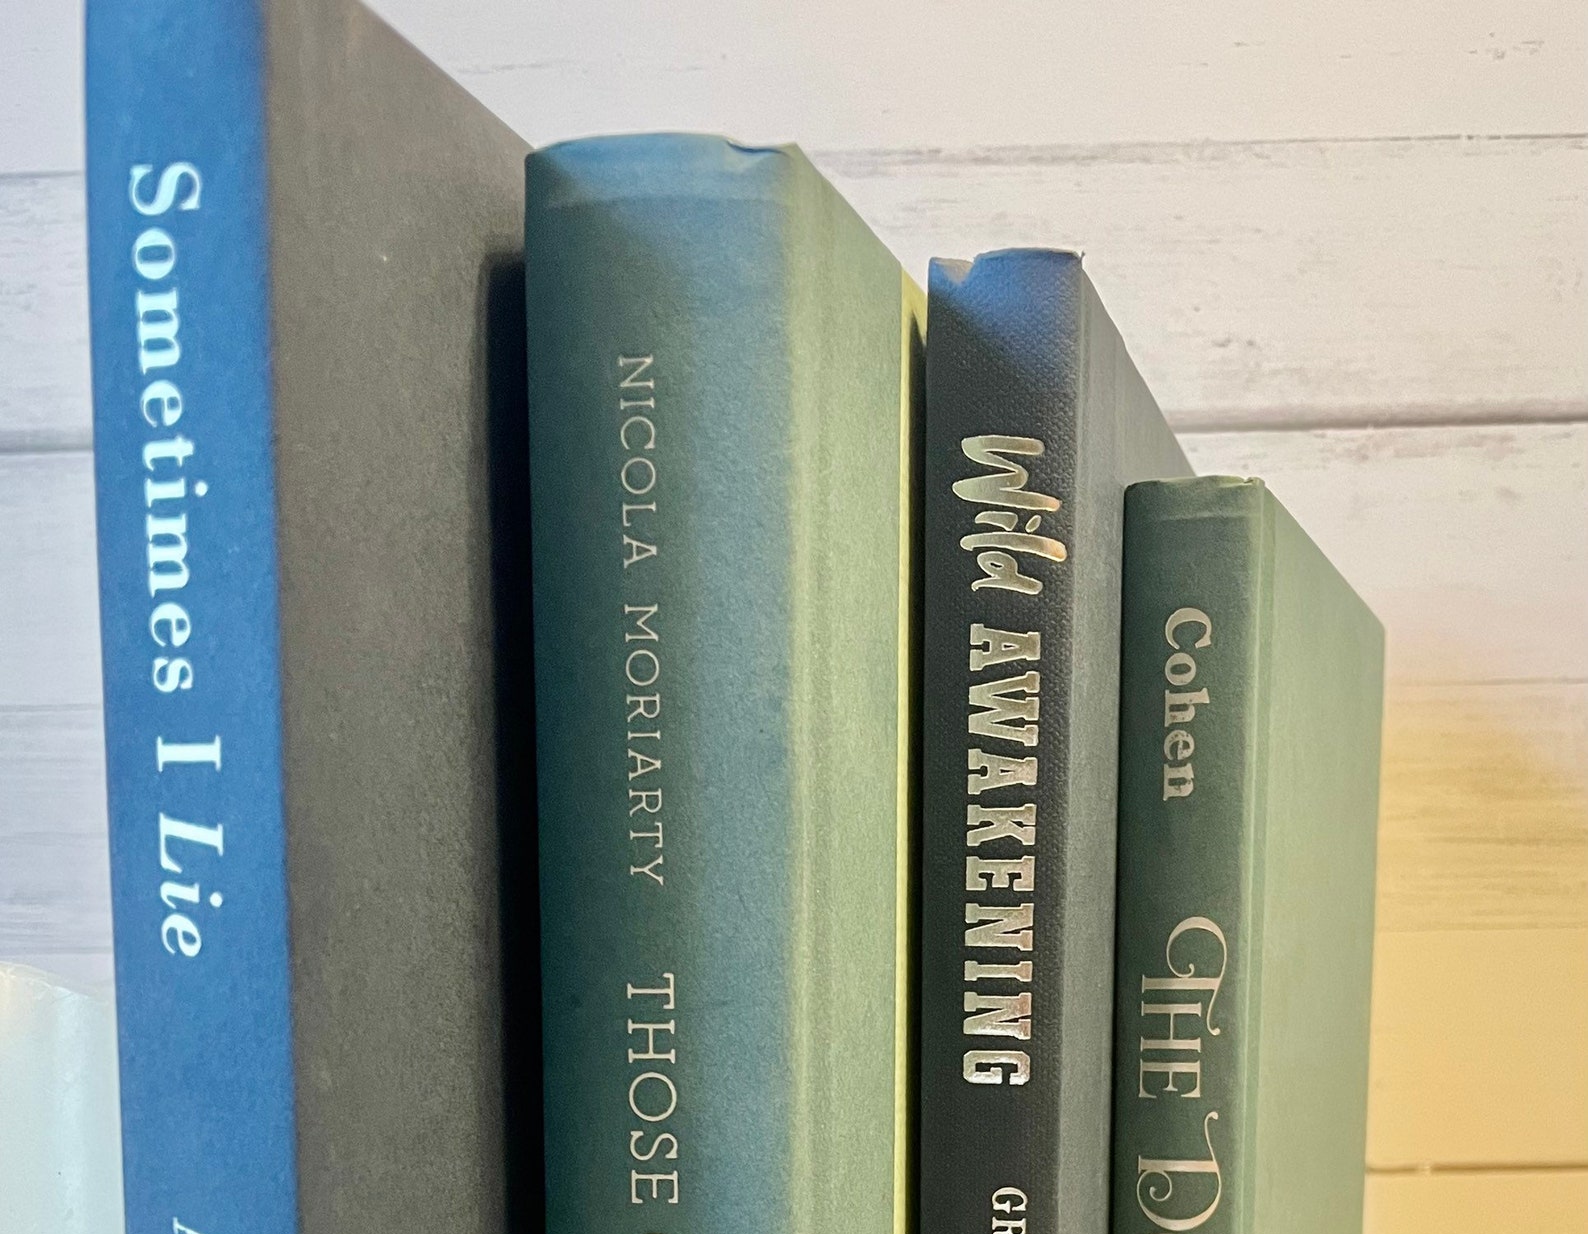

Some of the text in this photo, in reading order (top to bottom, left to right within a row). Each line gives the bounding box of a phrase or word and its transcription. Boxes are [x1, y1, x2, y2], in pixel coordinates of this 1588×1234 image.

[129, 160, 224, 958] Sometimes I Lie
[617, 353, 665, 886] NICOLA MORIARTY
[1162, 606, 1212, 801] Cohen
[951, 434, 1067, 1089] Wild AWAKENING
[626, 972, 680, 1206] THOSE
[1138, 915, 1228, 1099] THE
